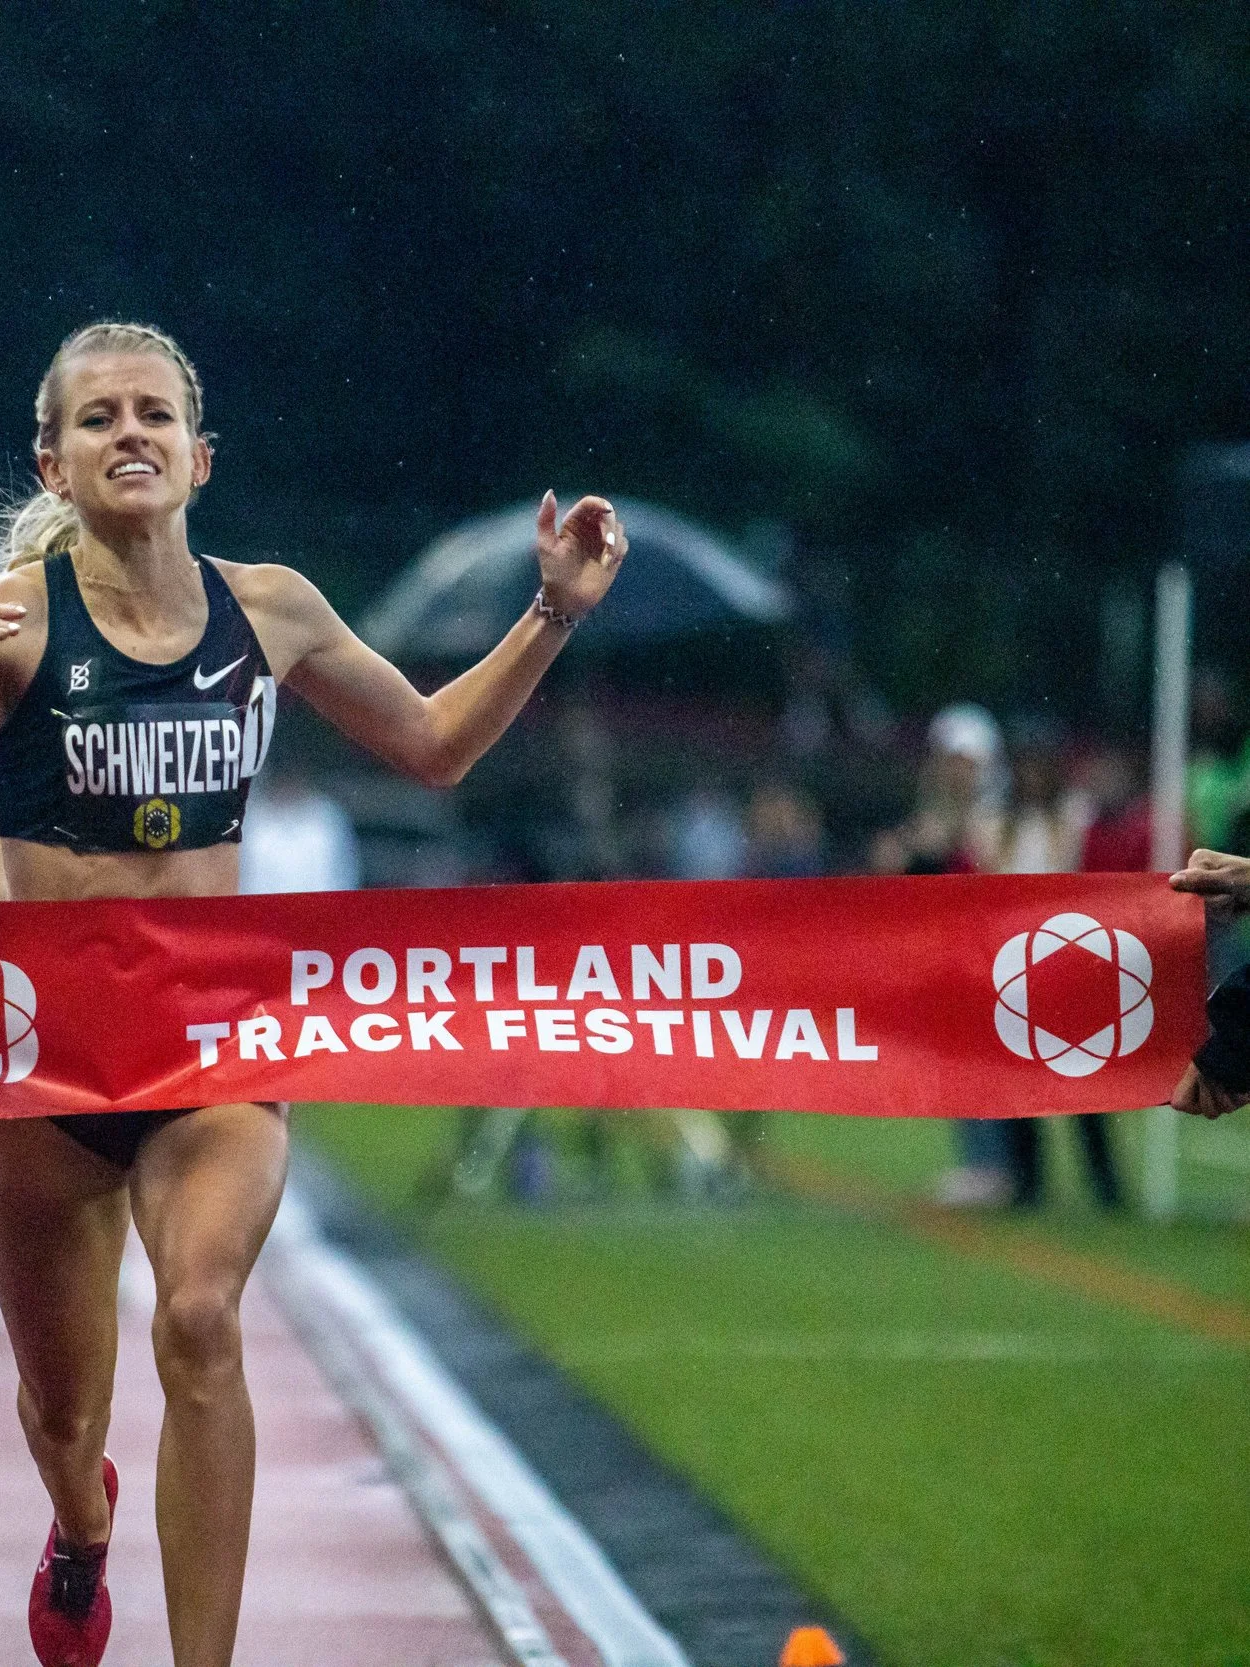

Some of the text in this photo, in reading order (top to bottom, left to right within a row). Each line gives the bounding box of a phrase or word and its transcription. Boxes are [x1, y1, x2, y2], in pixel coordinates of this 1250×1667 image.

[65, 719, 241, 795] SCHWEIZER
[290, 943, 743, 1006] PORTLAND
[185, 1007, 879, 1069] TRACK FESTIVAL
